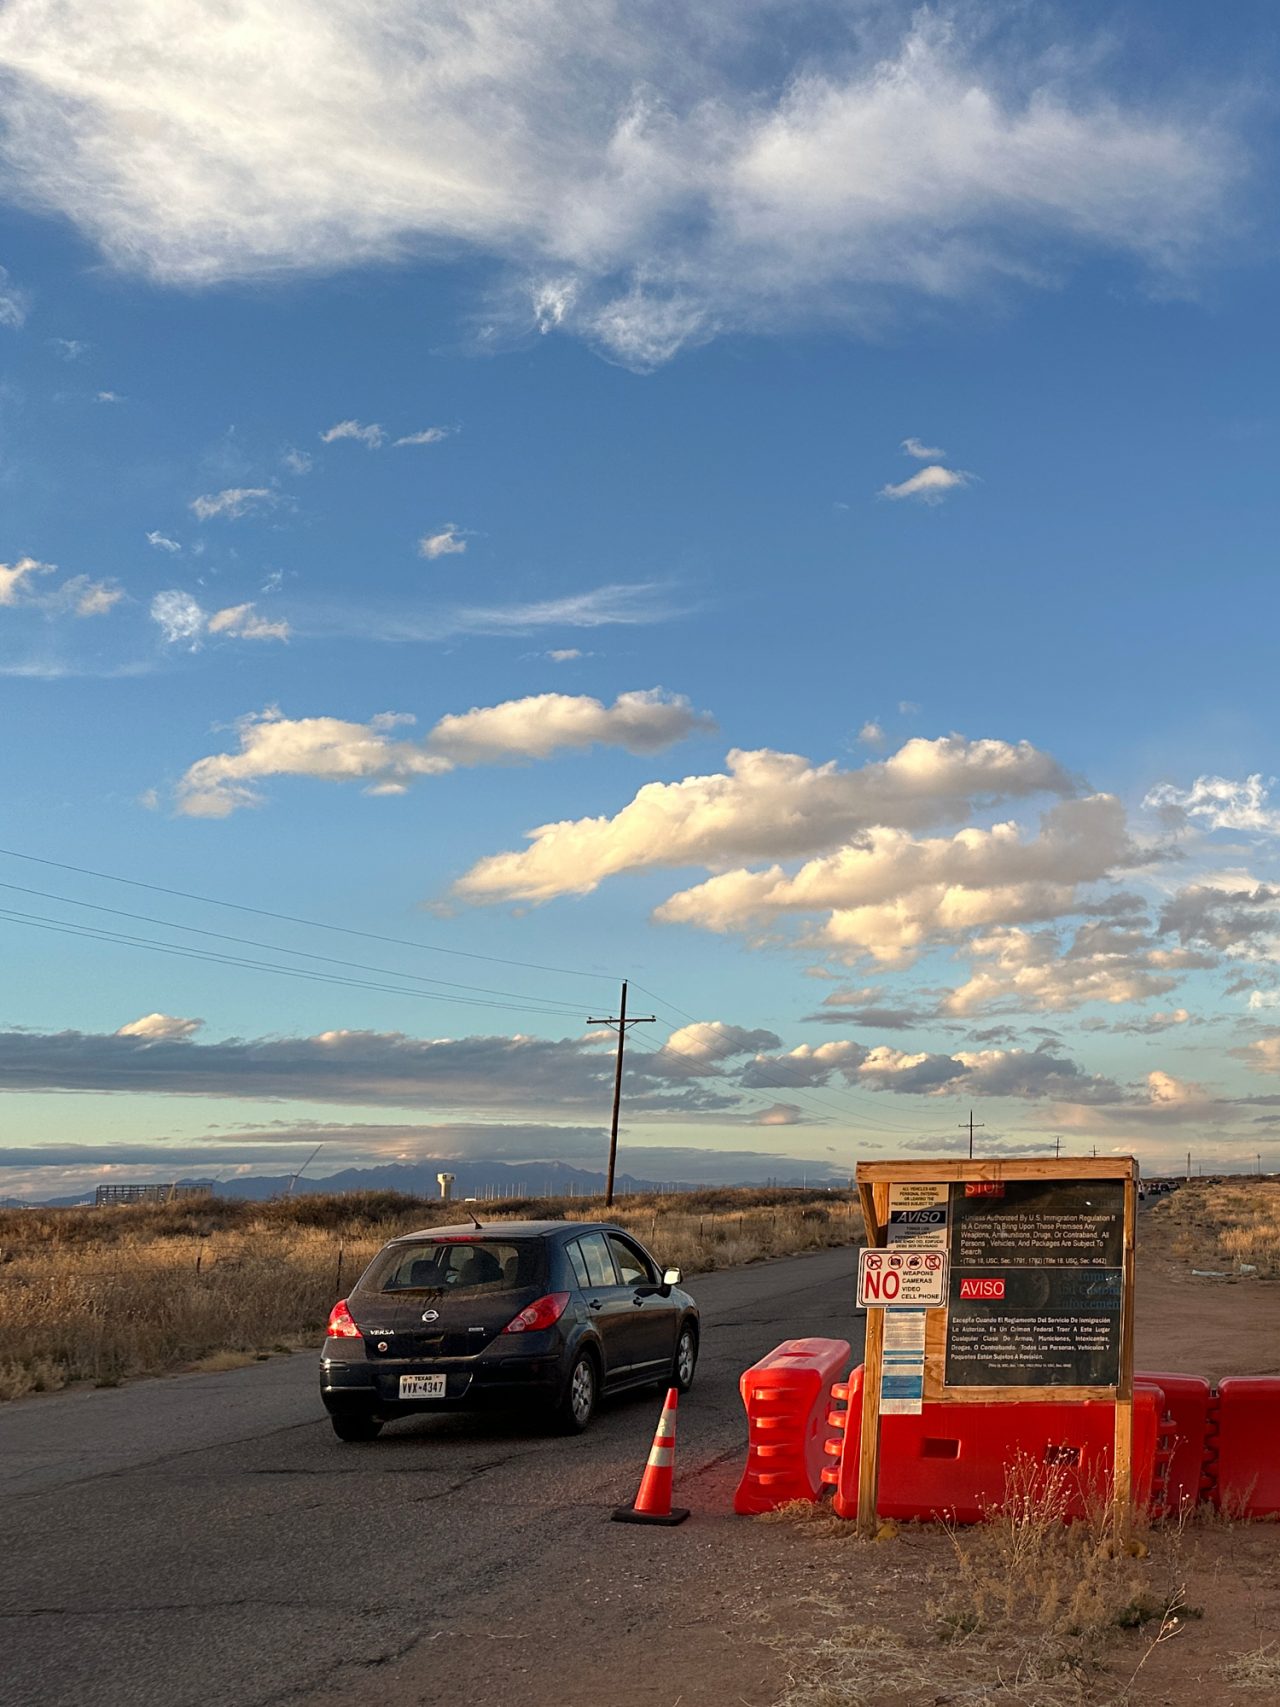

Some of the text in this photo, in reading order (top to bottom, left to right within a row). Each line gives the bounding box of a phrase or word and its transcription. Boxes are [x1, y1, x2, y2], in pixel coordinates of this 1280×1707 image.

[965, 1182, 1004, 1194] STOP
[896, 1212, 940, 1223] AVISO
[1043, 1214, 1077, 1222] Immigration
[1079, 1214, 1110, 1222] Regulation
[1002, 1223, 1017, 1231] Bring
[1084, 1223, 1096, 1231] Any
[1031, 1240, 1060, 1248] Packages
[1073, 1240, 1095, 1248] Subject
[864, 1271, 900, 1299] NO
[960, 1282, 1005, 1295] AVISO
